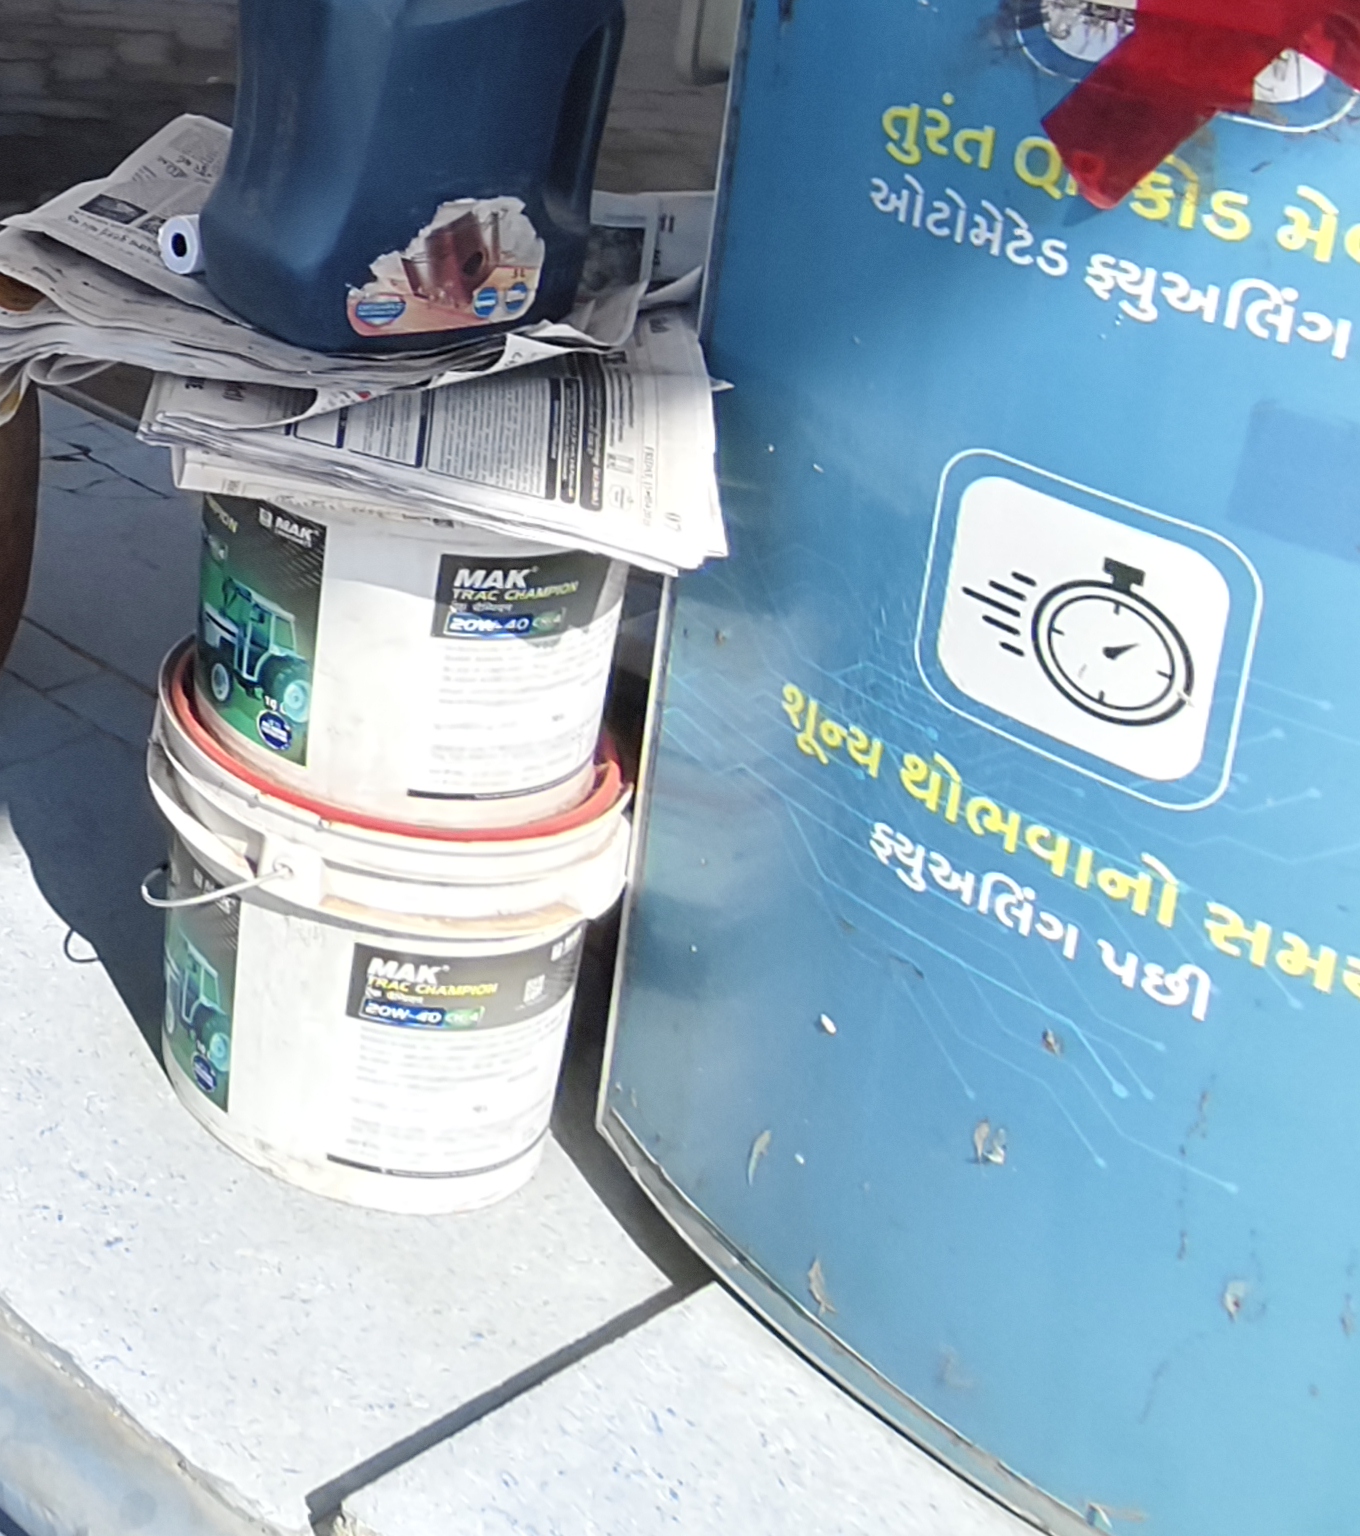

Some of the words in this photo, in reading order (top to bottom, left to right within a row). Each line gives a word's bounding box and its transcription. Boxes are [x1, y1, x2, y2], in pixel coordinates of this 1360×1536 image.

[881, 91, 997, 170] તુરંત
[868, 173, 1070, 277] ઓટોમેટેડ
[1083, 252, 1353, 360] ફ્યુઅલિંગ
[275, 517, 313, 540] MAK
[453, 568, 531, 589] MAK
[452, 588, 499, 601] TRAC
[504, 581, 579, 602] CHAMPION
[449, 618, 530, 631] 20W-40
[780, 682, 884, 780] શૂન્ય
[899, 751, 1180, 929] થોભવાનો
[868, 820, 1080, 960] ફ્યુઅલિંગ
[1097, 938, 1213, 1023] પછી
[367, 957, 441, 984] MAK
[367, 976, 410, 992] TRAC
[415, 982, 498, 998] CHAMPION
[365, 1003, 442, 1024] 20W-40
